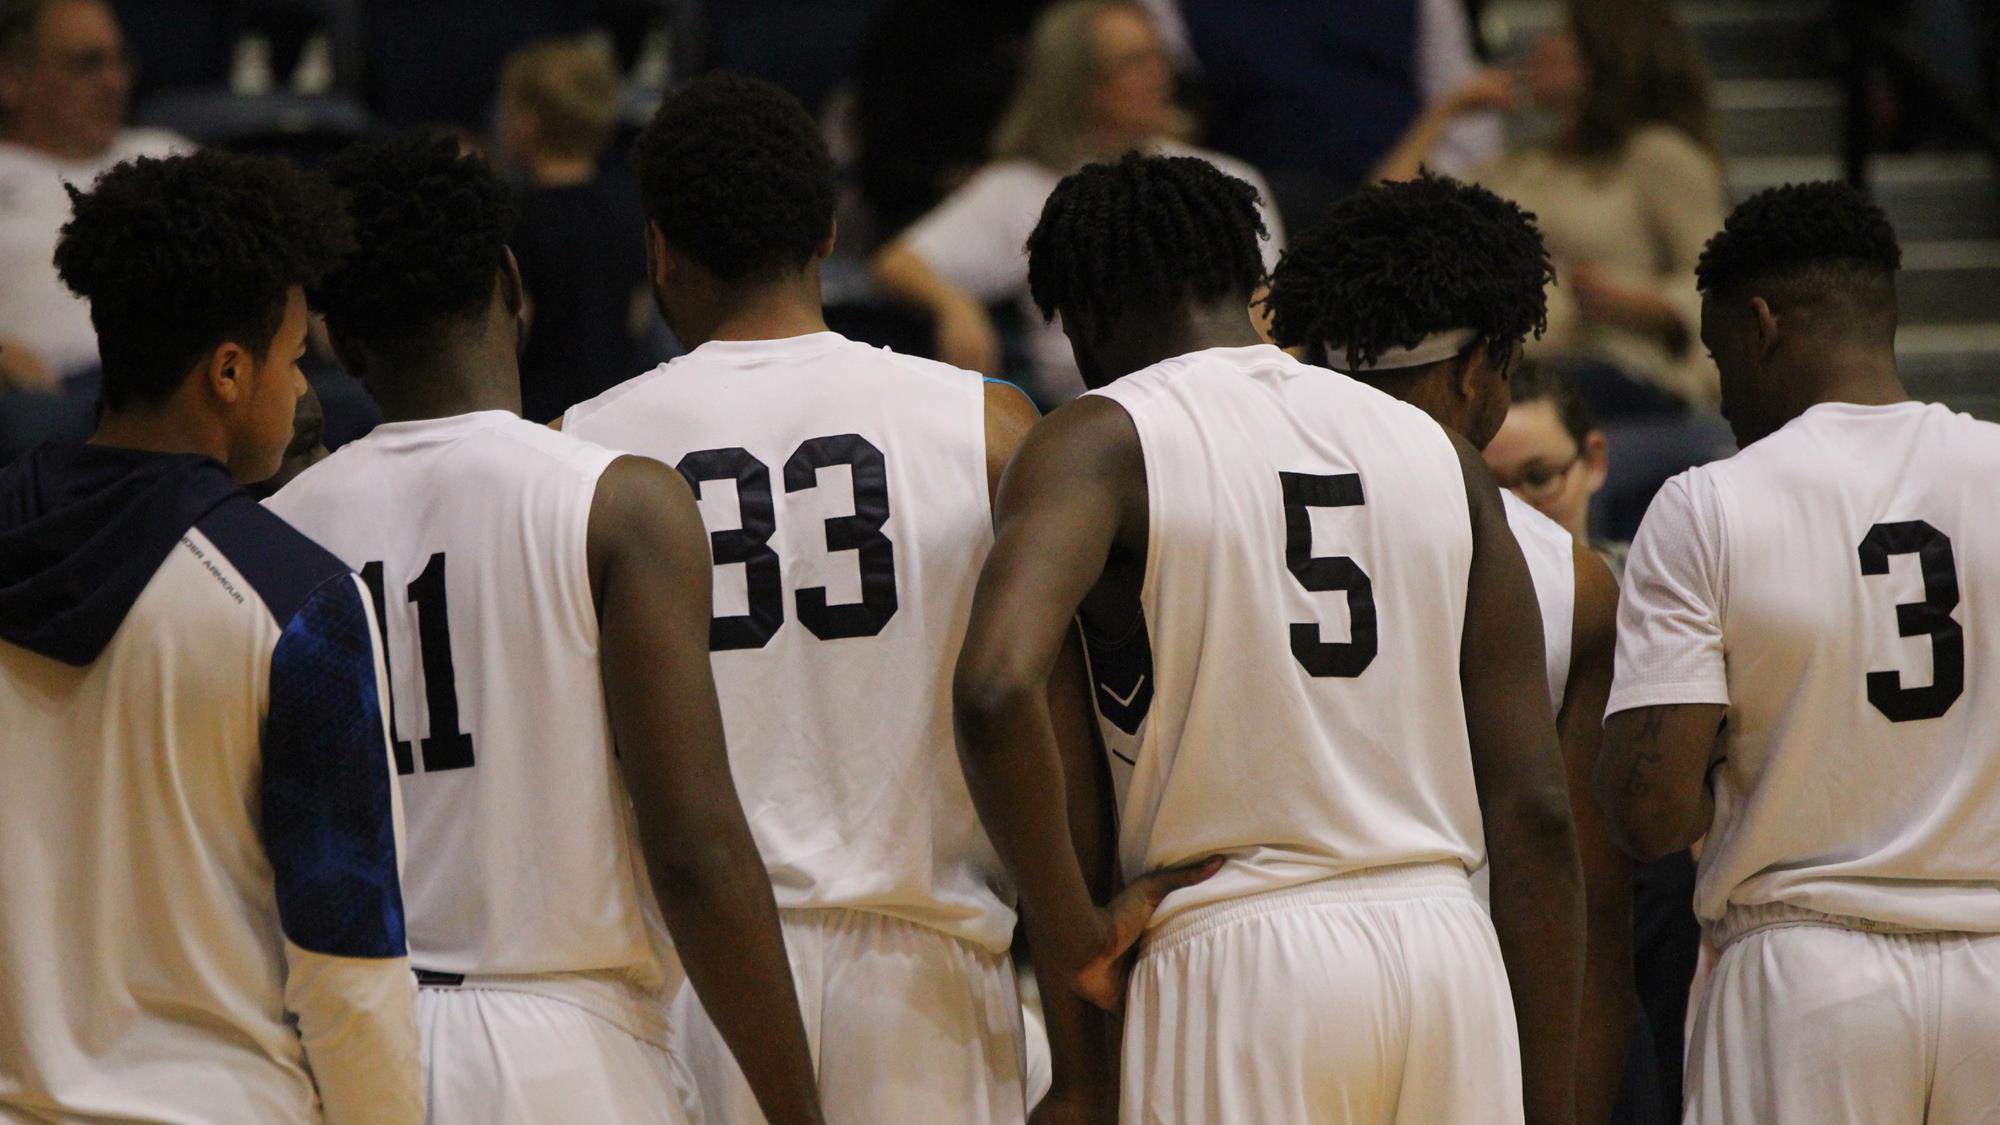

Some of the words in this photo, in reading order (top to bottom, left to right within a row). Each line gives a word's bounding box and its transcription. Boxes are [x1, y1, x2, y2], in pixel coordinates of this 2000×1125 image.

[203, 561, 244, 604] ARMOUR
[676, 434, 898, 652] 33
[1279, 471, 1378, 678] 5
[1858, 520, 1965, 723] 3
